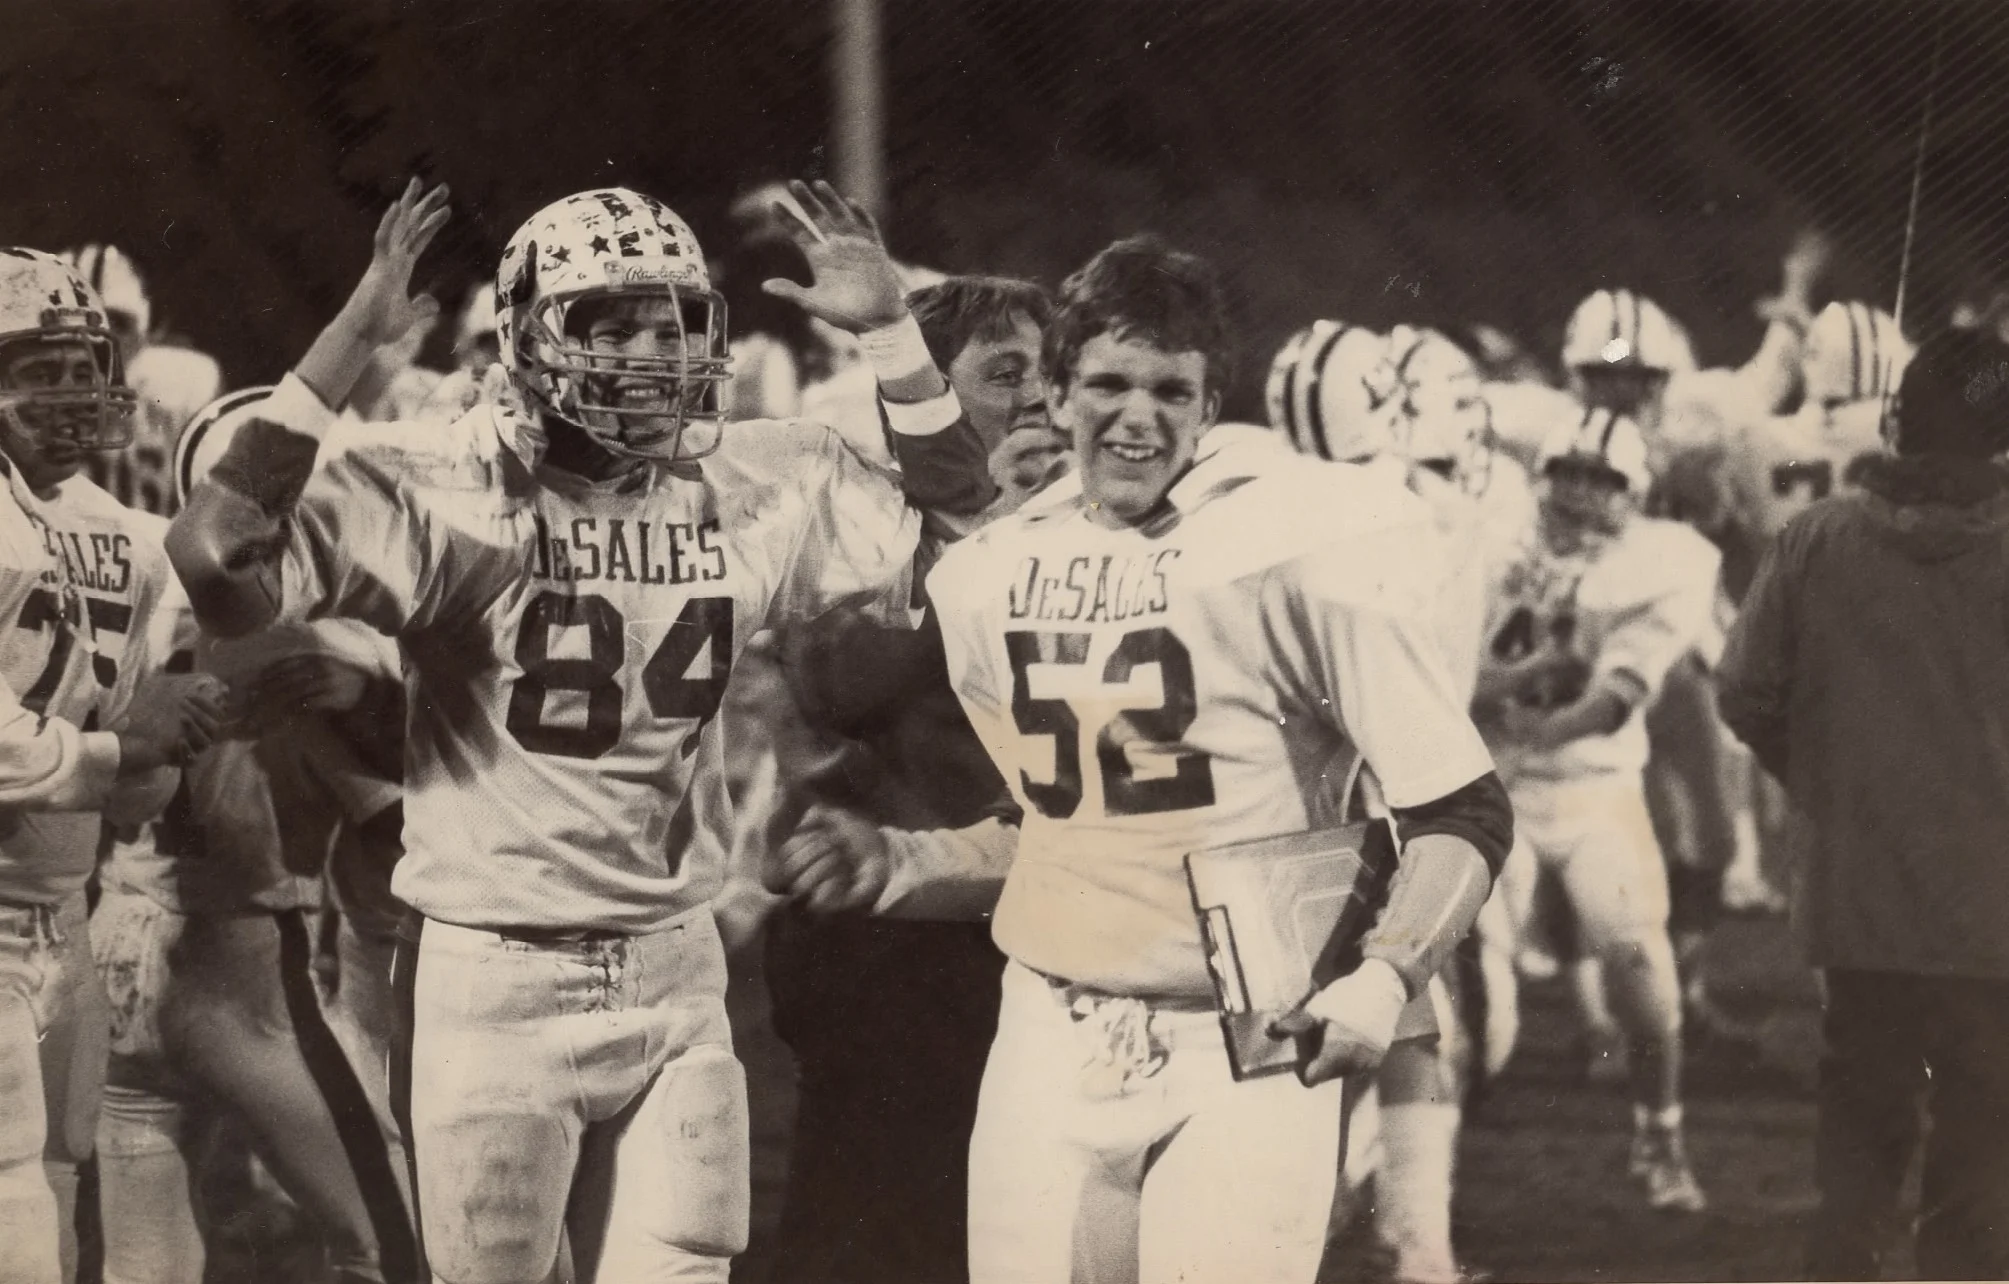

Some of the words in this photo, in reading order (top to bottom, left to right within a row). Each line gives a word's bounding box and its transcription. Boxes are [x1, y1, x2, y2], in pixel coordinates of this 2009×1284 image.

[17, 587, 133, 735] 75
[505, 590, 734, 760] 84
[1004, 626, 1216, 818] 52
